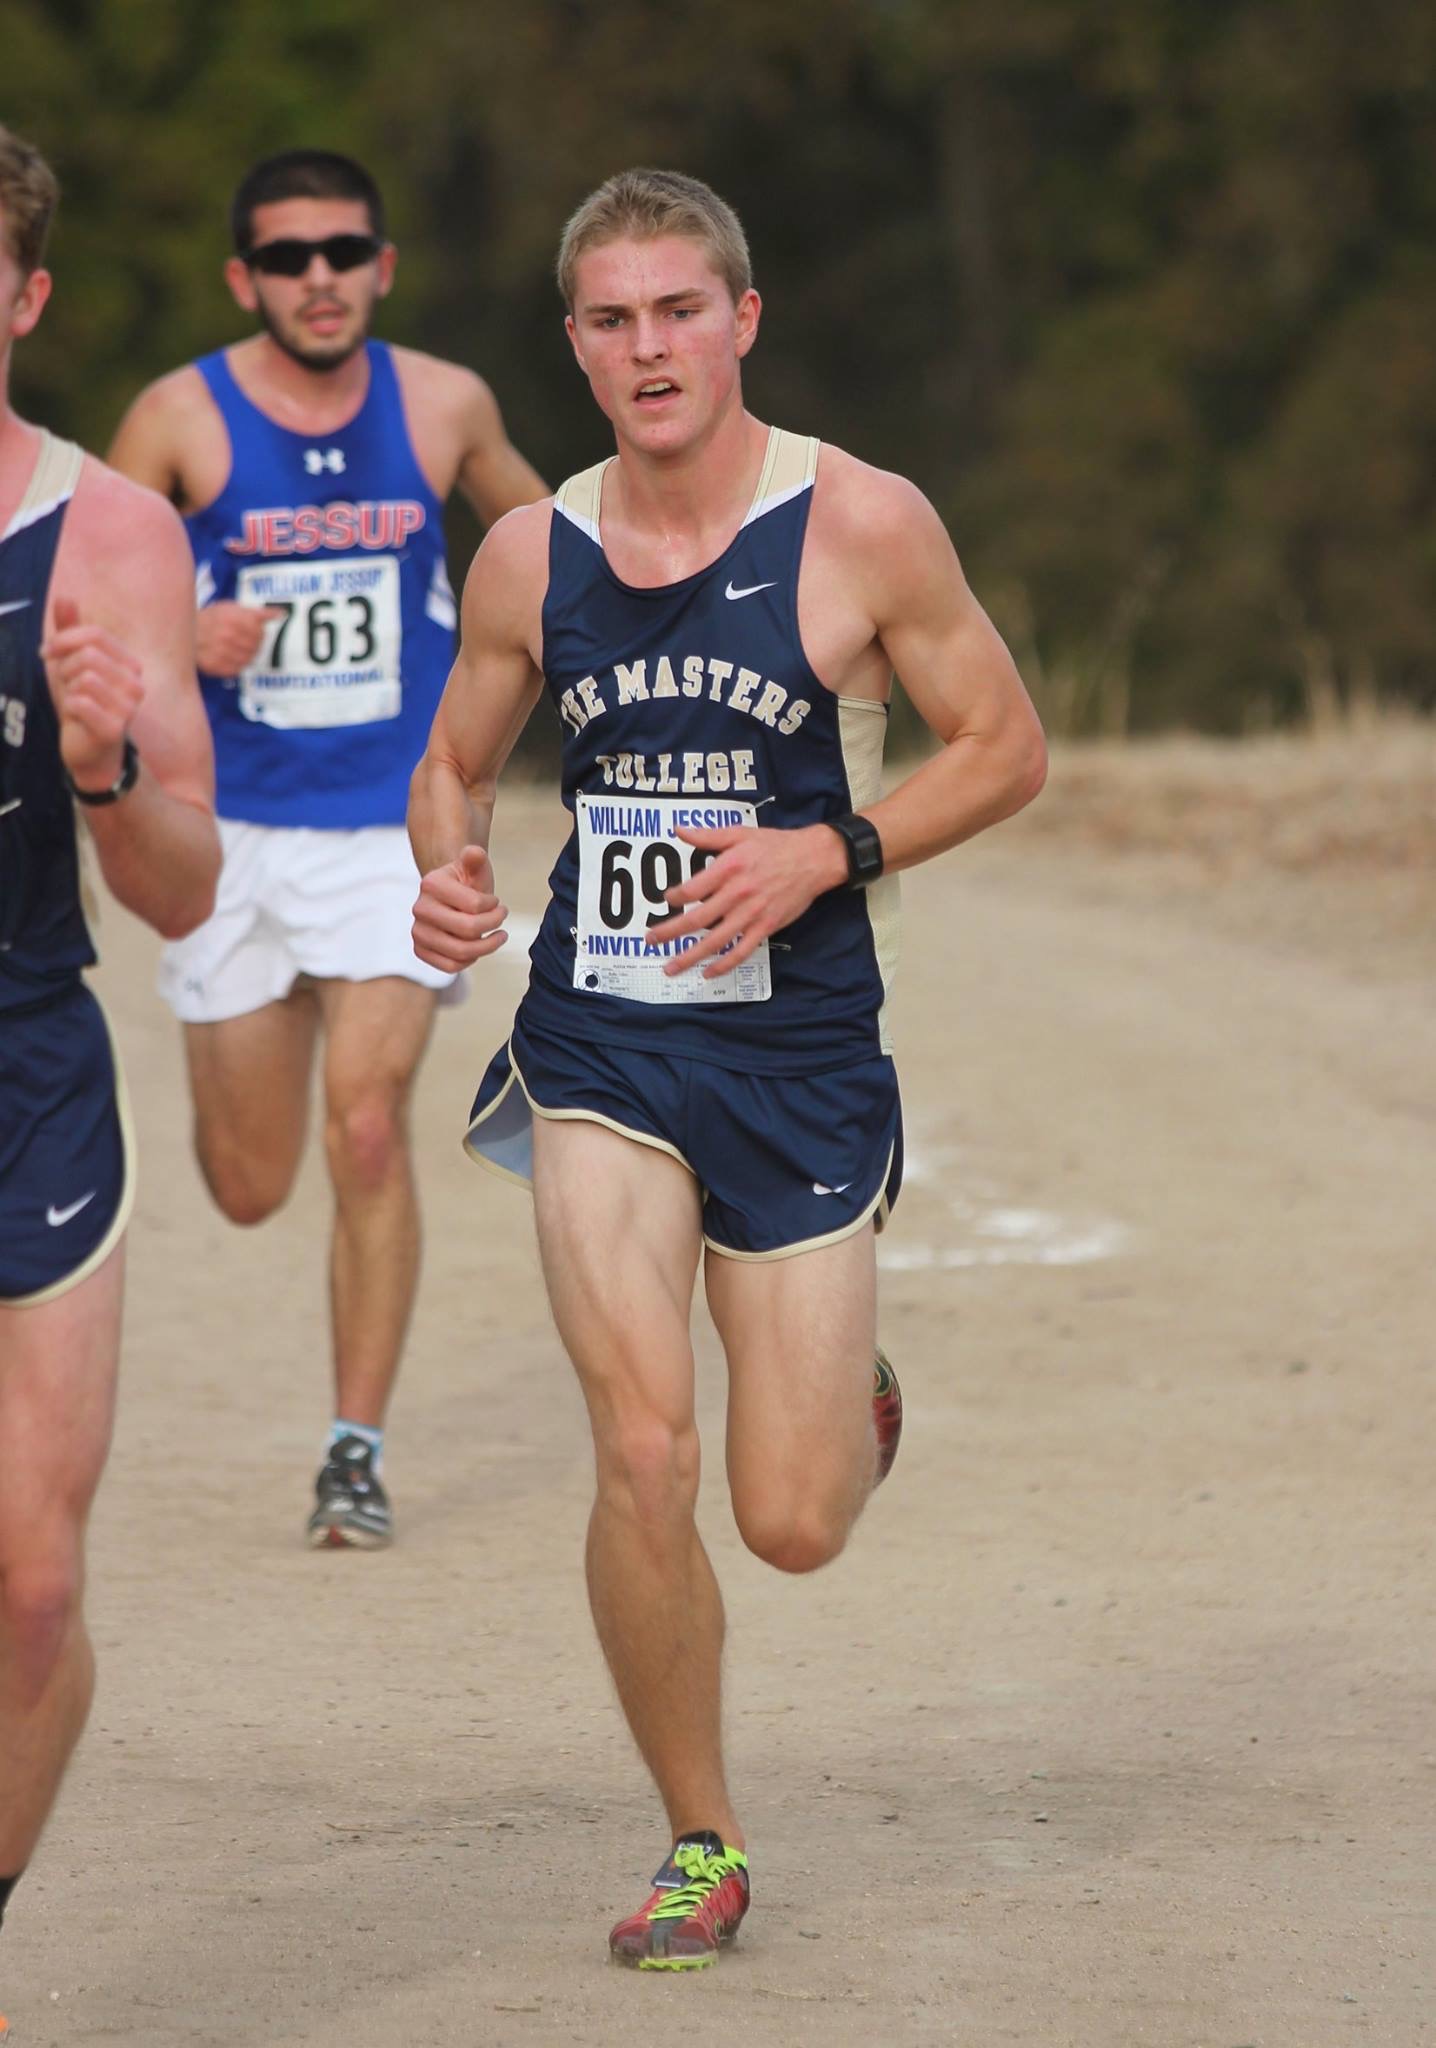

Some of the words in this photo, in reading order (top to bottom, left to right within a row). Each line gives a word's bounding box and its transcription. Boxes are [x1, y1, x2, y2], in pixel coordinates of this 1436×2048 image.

[224, 500, 426, 557] JESSUP
[263, 595, 375, 669] 763
[613, 655, 811, 736] MASTERS
[588, 805, 661, 838] WILLIAM
[599, 840, 724, 931] 69
